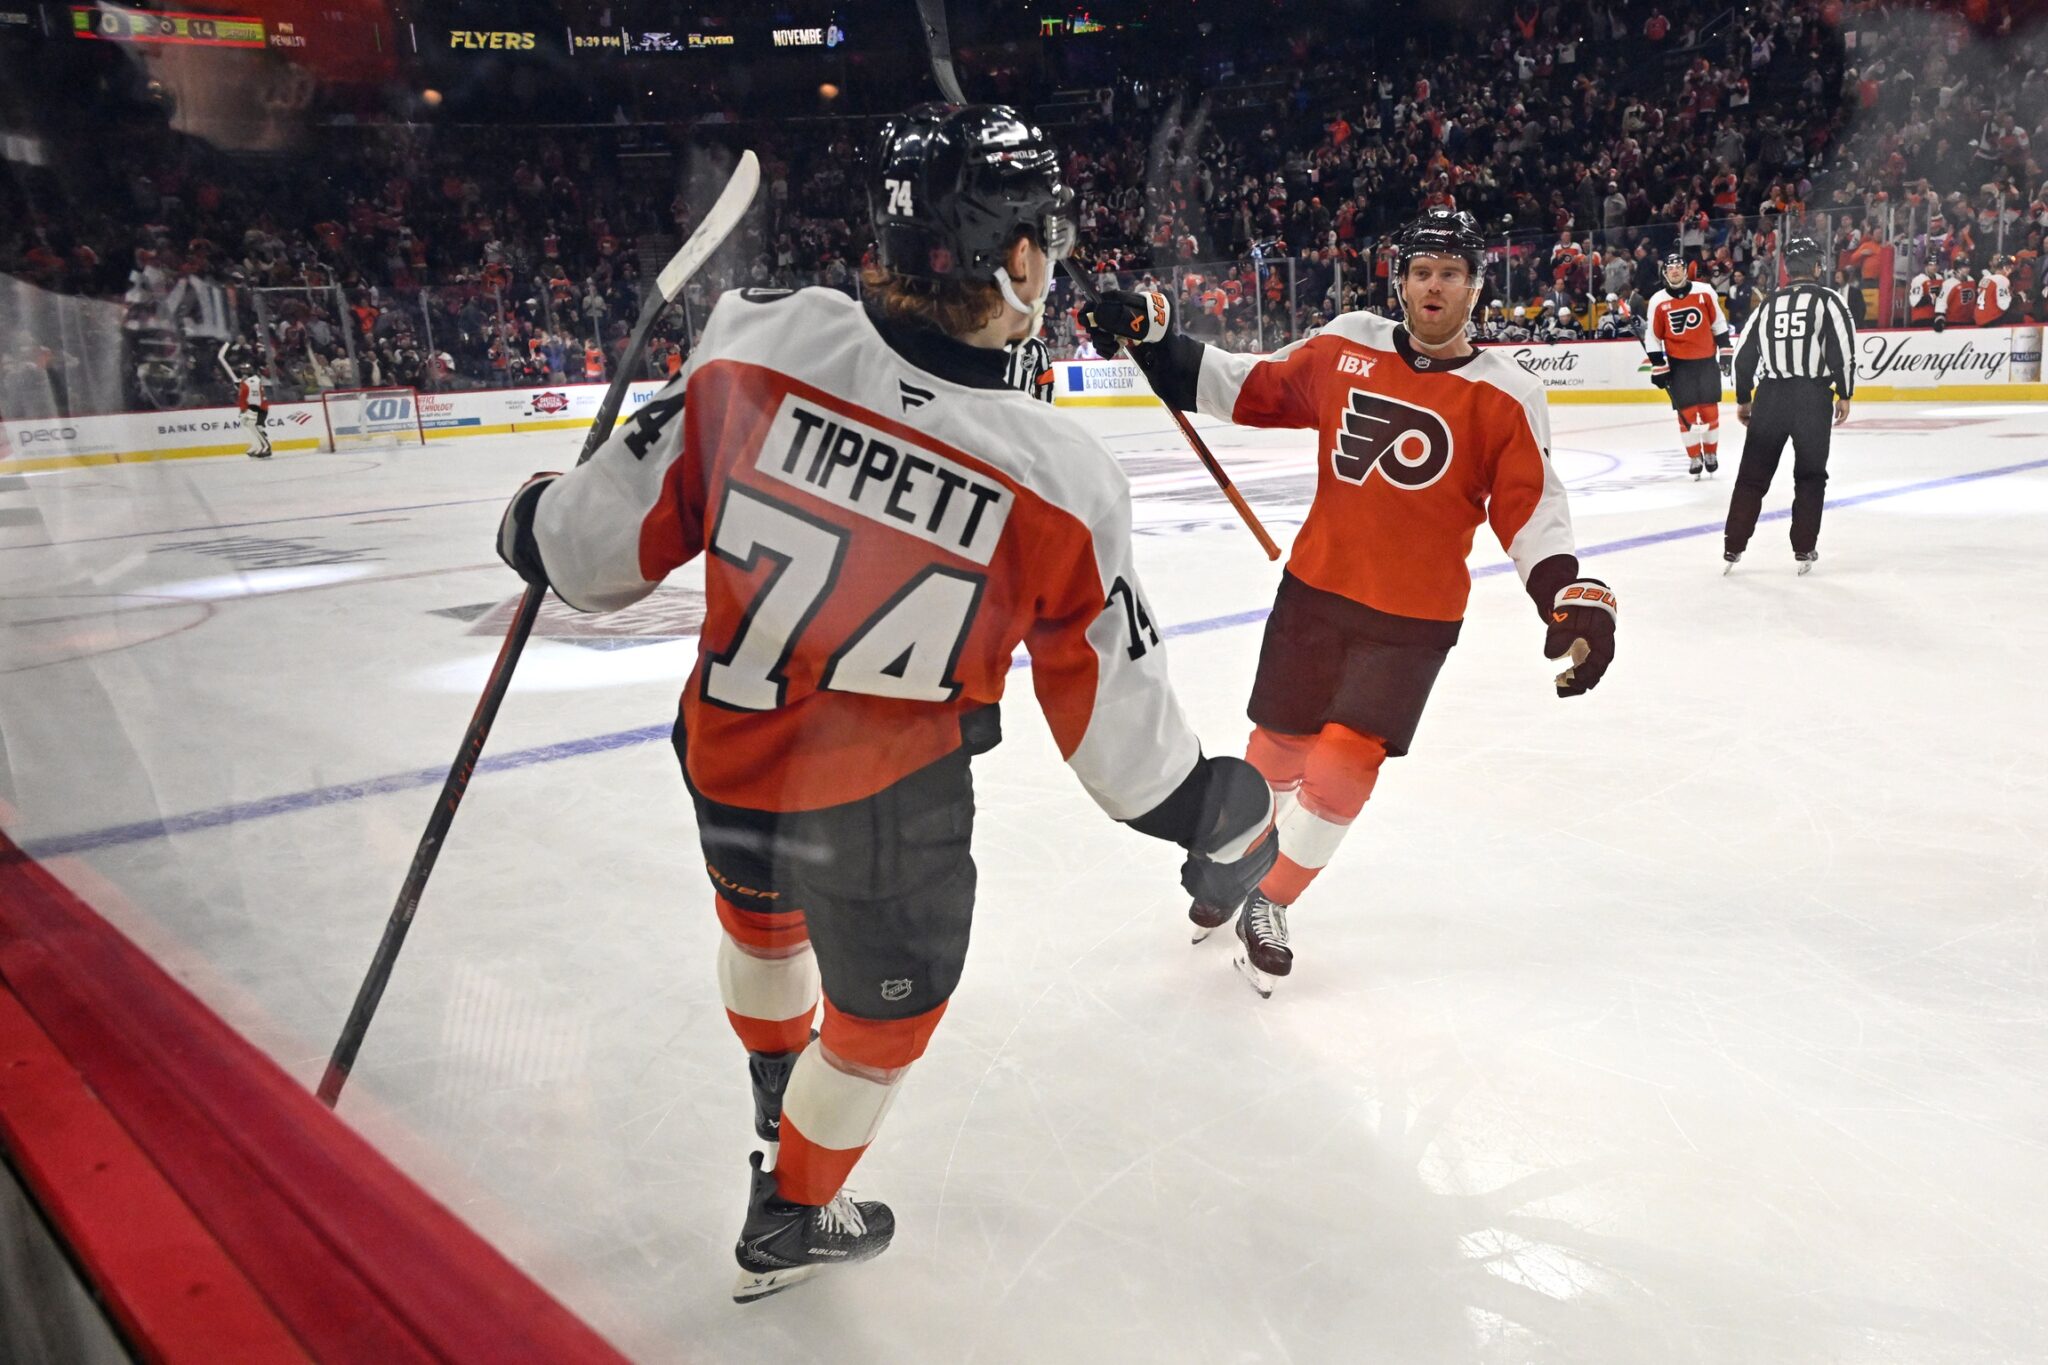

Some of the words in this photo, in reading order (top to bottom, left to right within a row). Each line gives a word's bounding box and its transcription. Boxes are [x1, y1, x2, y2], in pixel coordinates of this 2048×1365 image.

[450, 30, 536, 50] FLYERS
[602, 36, 621, 48] PM
[885, 178, 914, 217] 74
[1774, 311, 1806, 339] 95
[1336, 354, 1376, 378] IBX
[1513, 348, 1579, 377] Sports
[1857, 336, 2011, 380] Yuengling
[1093, 378, 1134, 389] BUCKELEW
[19, 427, 77, 447] peco
[158, 423, 197, 435] BANK
[201, 422, 219, 431] OF
[784, 406, 1002, 549] TIPPETT
[701, 475, 988, 713] 74
[705, 863, 780, 900] AUER
